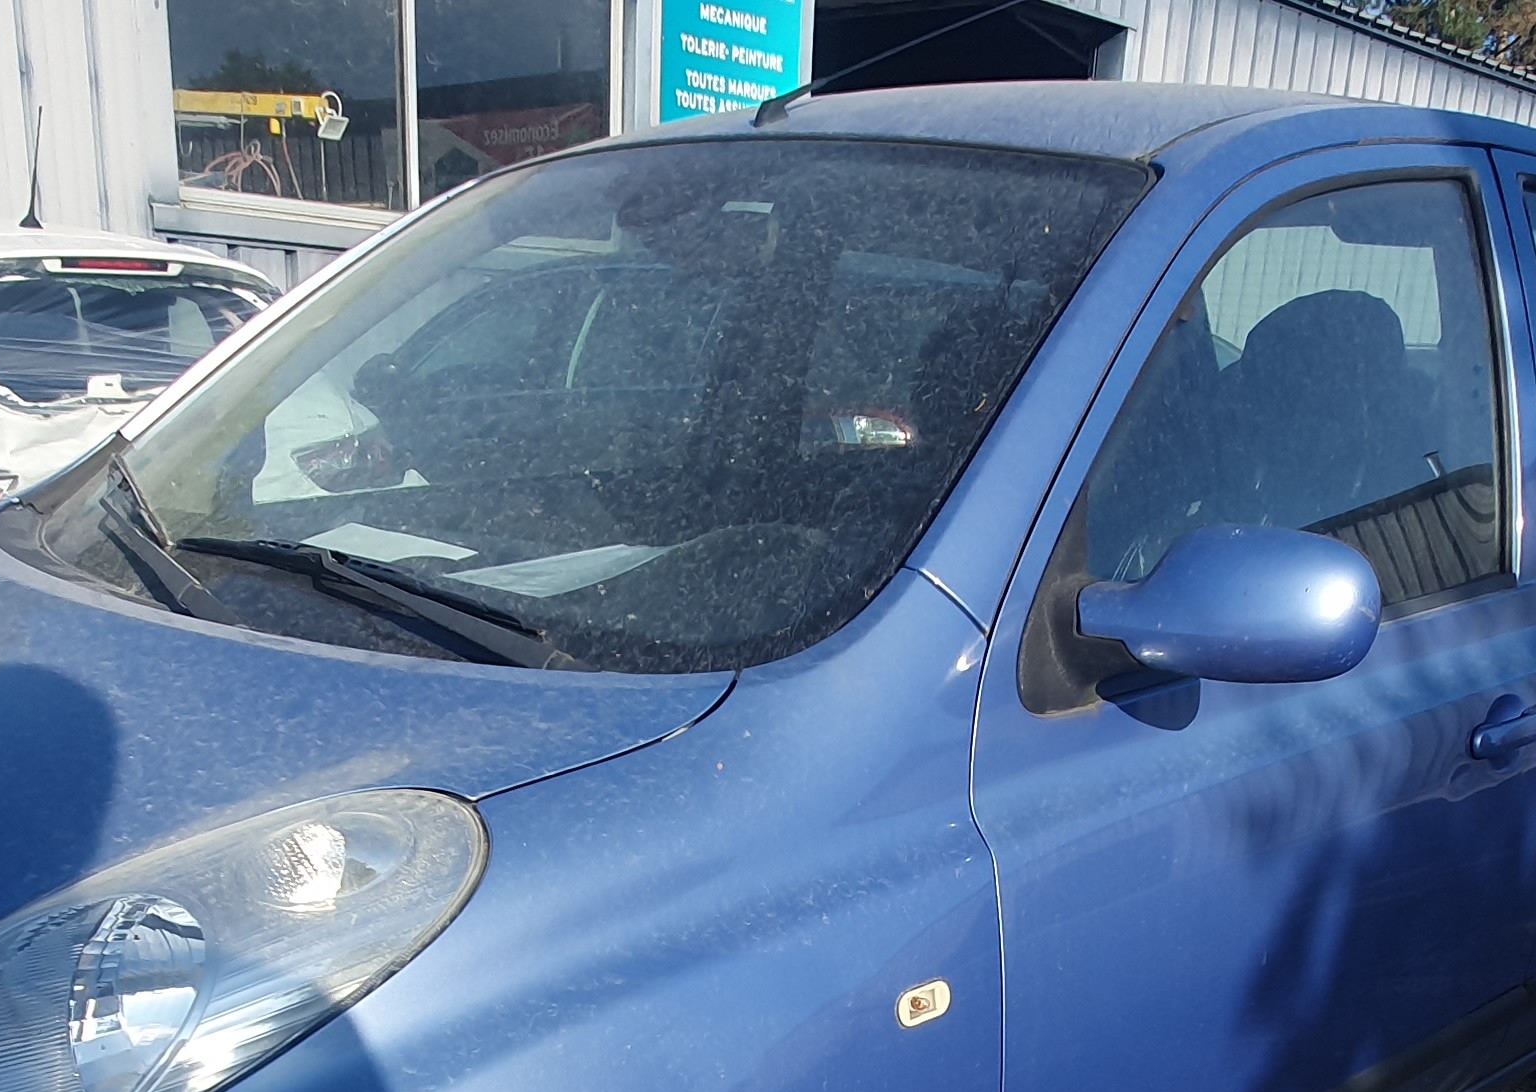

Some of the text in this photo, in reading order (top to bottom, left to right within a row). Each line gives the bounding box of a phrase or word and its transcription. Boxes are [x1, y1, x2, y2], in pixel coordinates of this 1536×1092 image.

[700, 2, 767, 35] MECANIQUE
[732, 45, 783, 73] PEINTURE
[686, 69, 726, 93] TOUTES
[676, 89, 716, 114] TOUTES
